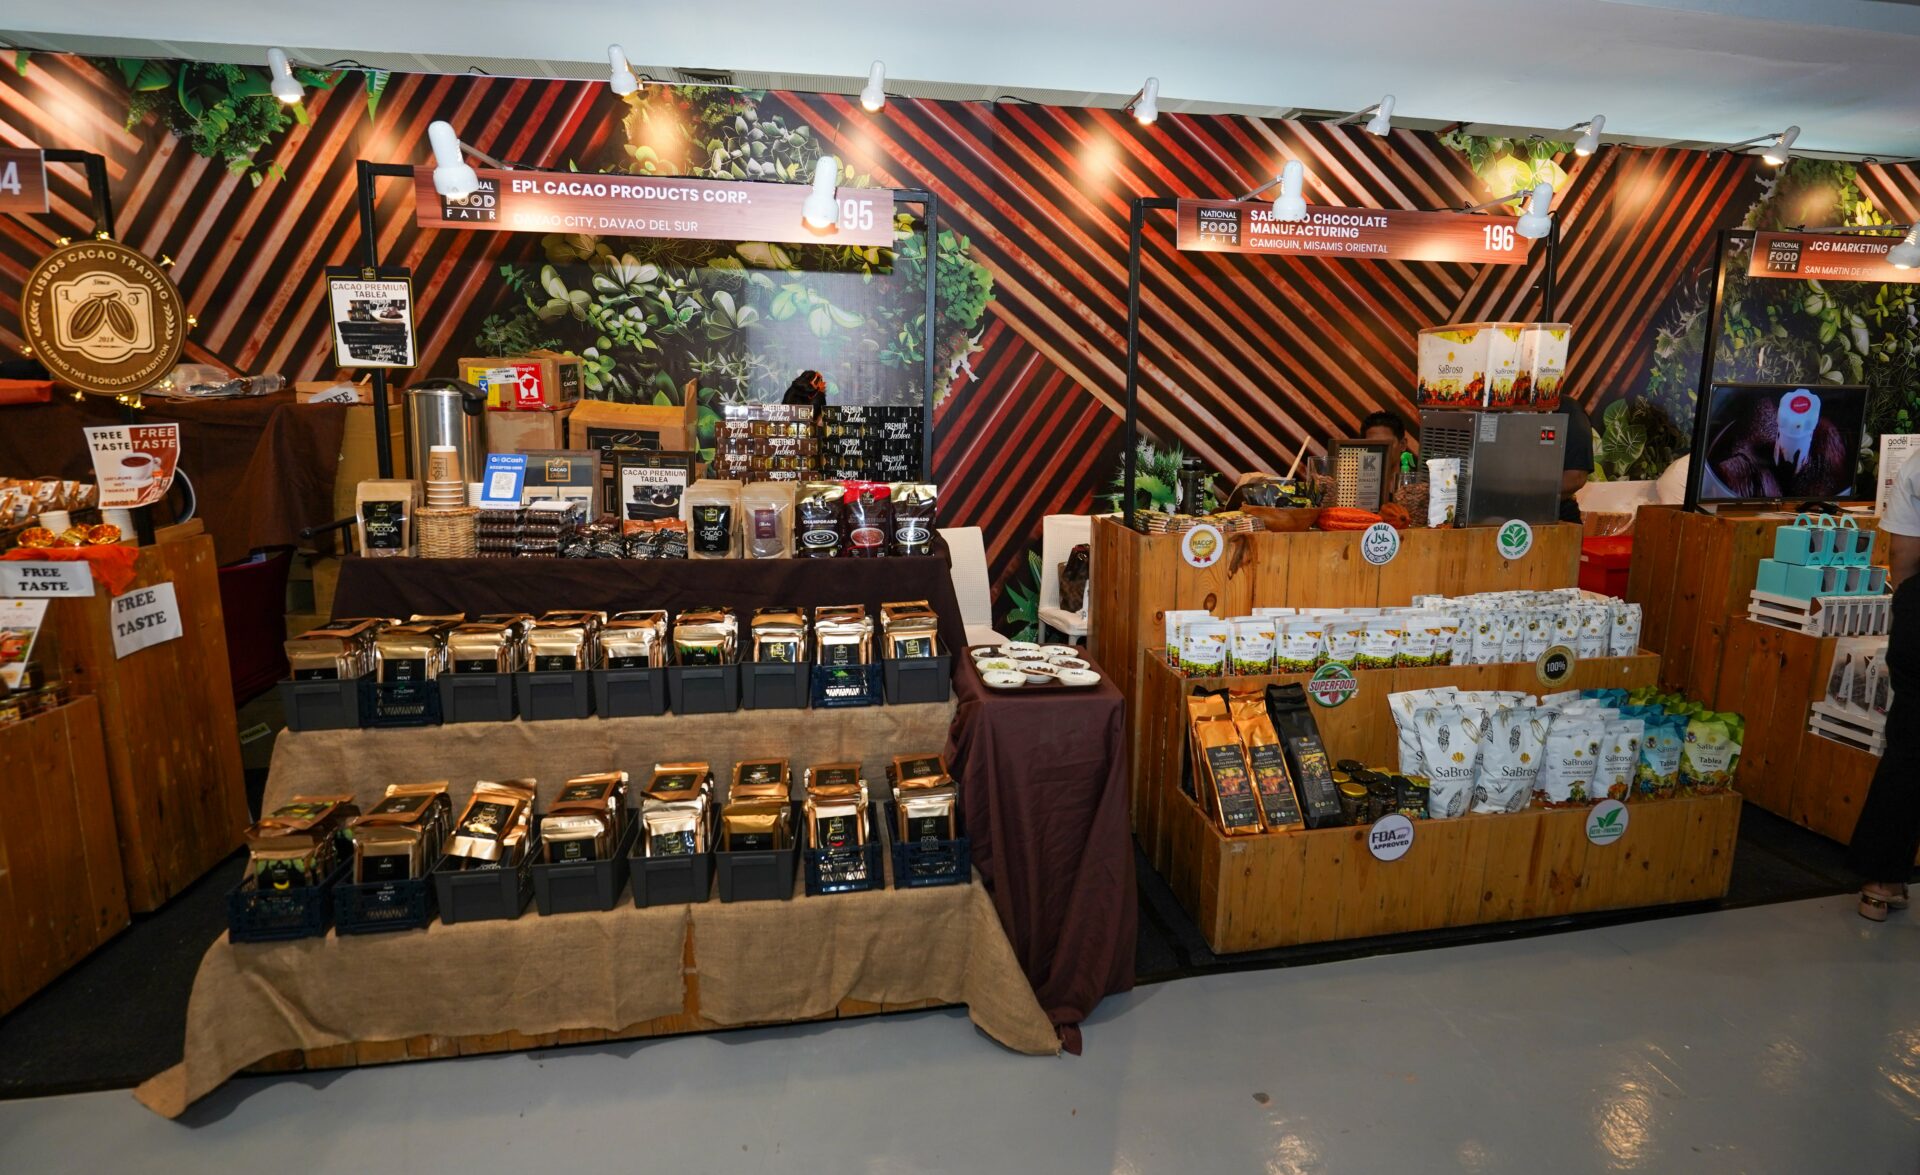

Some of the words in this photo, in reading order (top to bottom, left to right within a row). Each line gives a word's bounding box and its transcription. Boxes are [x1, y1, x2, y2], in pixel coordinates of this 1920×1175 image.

[0, 160, 20, 197] 4
[512, 180, 540, 194] EPL
[544, 182, 607, 198] CACAO
[611, 185, 699, 202] PRODUCTS
[702, 190, 752, 204] CORP.
[446, 209, 496, 220] FAIR
[1200, 210, 1237, 219] NATIONAL
[1250, 210, 1310, 223] SABO
[1313, 213, 1388, 228] CHOCOLATE
[564, 216, 597, 229] CITY,
[599, 217, 646, 230] DAVAO
[649, 219, 671, 231] DEL
[674, 221, 698, 233] SUR
[1200, 221, 1238, 233] FOOD
[1250, 222, 1359, 239] MANUFACTURING
[1200, 234, 1237, 244] FAIR
[1482, 224, 1514, 252] 196
[1250, 238, 1302, 251] CAMIGUIN,
[1303, 240, 1343, 251] MISAMIS
[1345, 241, 1388, 254] ORIENTAL
[1809, 241, 1830, 251] JCG
[1831, 243, 1888, 254] MARKETING
[1768, 251, 1799, 262] FOOD
[1767, 263, 1797, 271] FAIR
[1804, 265, 1821, 274] SAN
[1822, 266, 1849, 275] MARTIN
[1850, 267, 1862, 275] DE
[33, 256, 66, 297] LISBOS
[67, 250, 117, 263] CACAO
[120, 255, 169, 300] TRADING
[331, 282, 362, 291] CACAO
[364, 283, 407, 291] PREMIUM
[354, 290, 387, 298] TABLEA
[40, 340, 70, 371] KEEPING
[70, 367, 86, 380] THE
[87, 374, 138, 386] TSOKOLATE
[137, 343, 170, 379] TRADITION
[1438, 364, 1464, 375] SaBroso
[762, 404, 790, 412] SWEETENED
[92, 431, 123, 440] FREE
[139, 427, 176, 438] FREE
[93, 442, 131, 451] TASTE
[132, 438, 177, 450] TASTE
[768, 438, 796, 446] SWEETENED
[769, 471, 796, 479] SWEETENED
[21, 567, 61, 578] FREE
[18, 581, 69, 591] TASTE
[117, 590, 157, 613] FREE
[117, 611, 167, 637] TASTE
[1546, 661, 1566, 673] 100%
[1309, 680, 1356, 692] SUPERFOOD
[1562, 758, 1592, 767] SaBroso
[1699, 756, 1722, 764] Tablea
[1435, 766, 1473, 778] SaBros
[1501, 765, 1537, 777] SaBros
[1372, 830, 1397, 844] FDA
[1373, 840, 1409, 850] APPROVED
